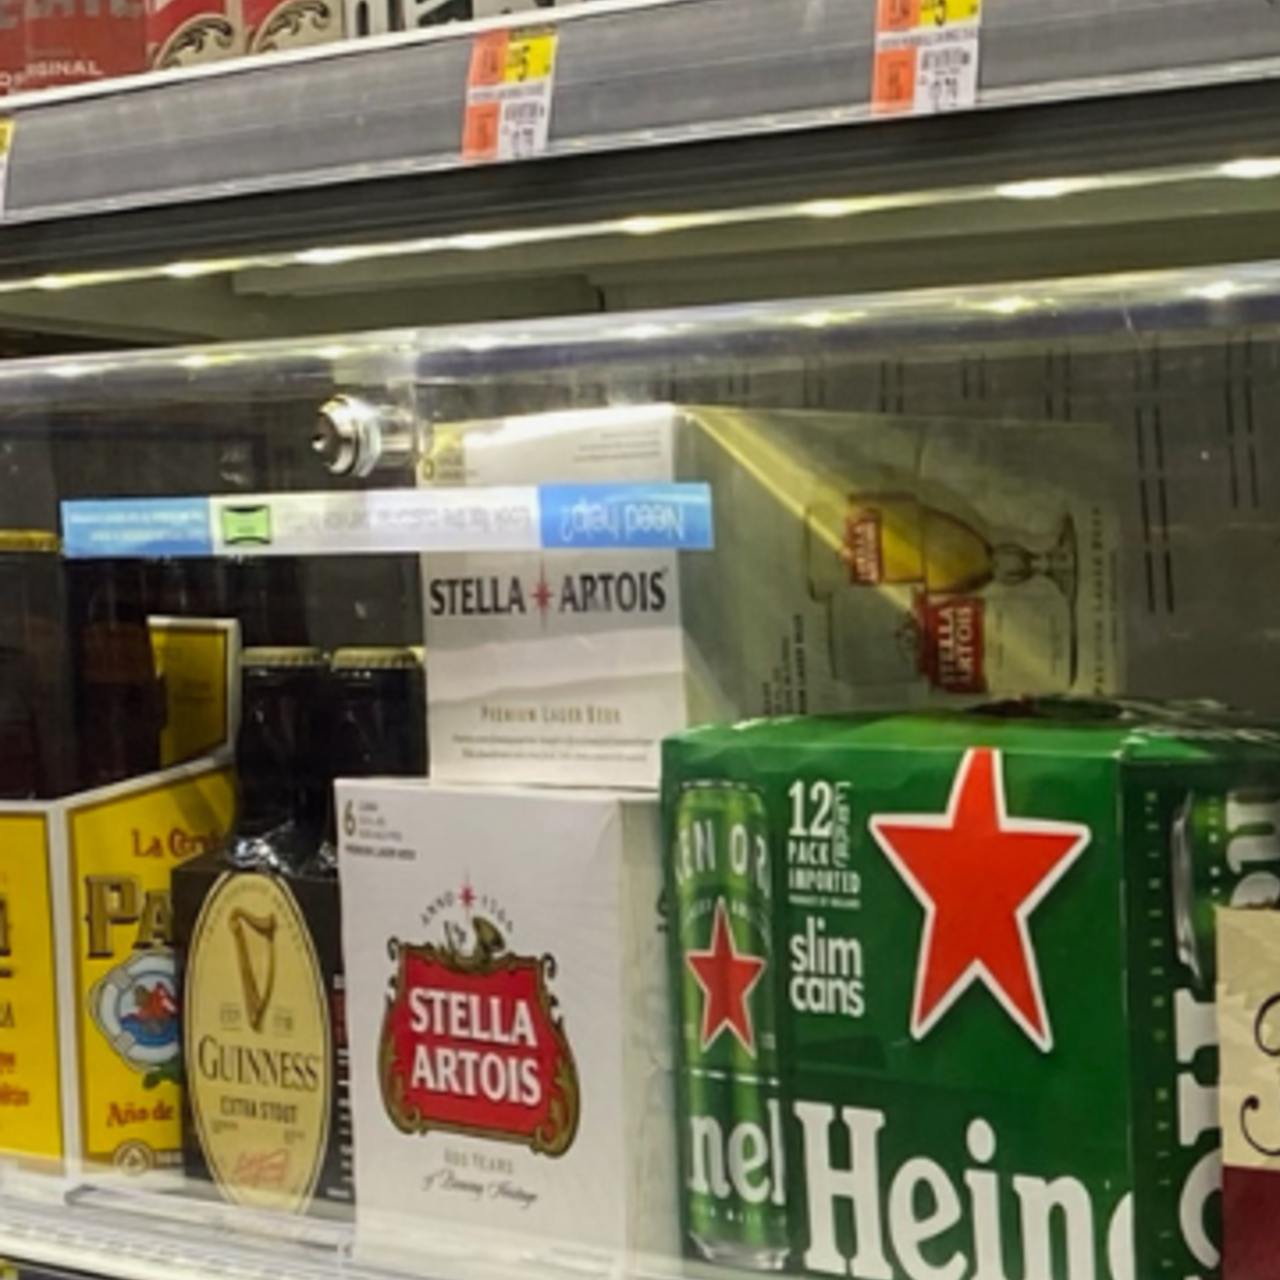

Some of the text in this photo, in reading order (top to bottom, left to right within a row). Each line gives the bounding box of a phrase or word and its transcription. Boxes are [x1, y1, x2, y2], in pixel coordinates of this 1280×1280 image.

[429, 570, 667, 617] STELLA ARTOIS
[787, 779, 834, 838] 12
[131, 828, 164, 859] La
[787, 839, 830, 865] PACK
[788, 870, 861, 897] IMPORTED
[790, 916, 863, 977] slim
[408, 986, 538, 1048] STELLA
[789, 972, 865, 1018] cans
[198, 1033, 319, 1091] GUINNESS
[411, 1044, 542, 1107] ARTOIS
